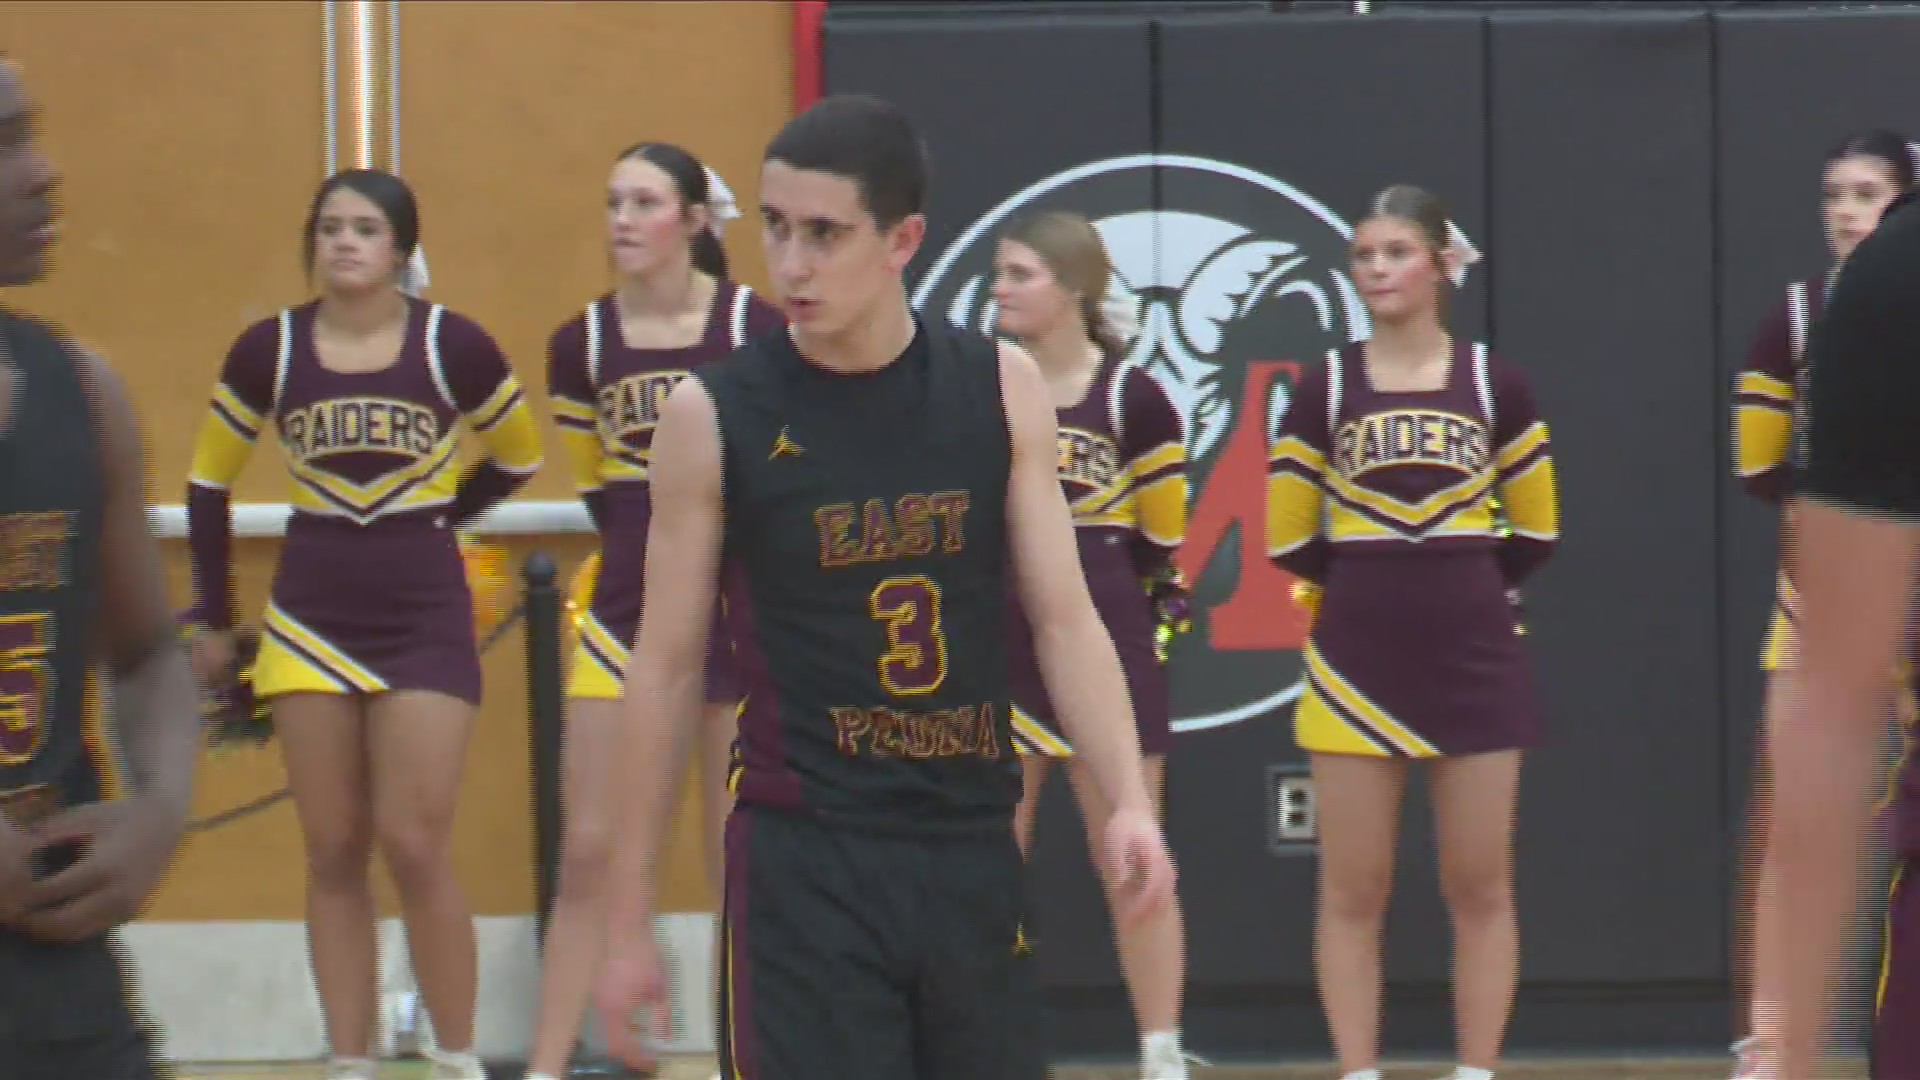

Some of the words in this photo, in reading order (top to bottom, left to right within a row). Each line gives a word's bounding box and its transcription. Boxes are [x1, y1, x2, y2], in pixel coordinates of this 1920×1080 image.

[285, 400, 436, 455] RAIDERS
[1336, 412, 1488, 475] RAIDERS
[813, 490, 970, 567] EAST
[869, 576, 948, 696] 3
